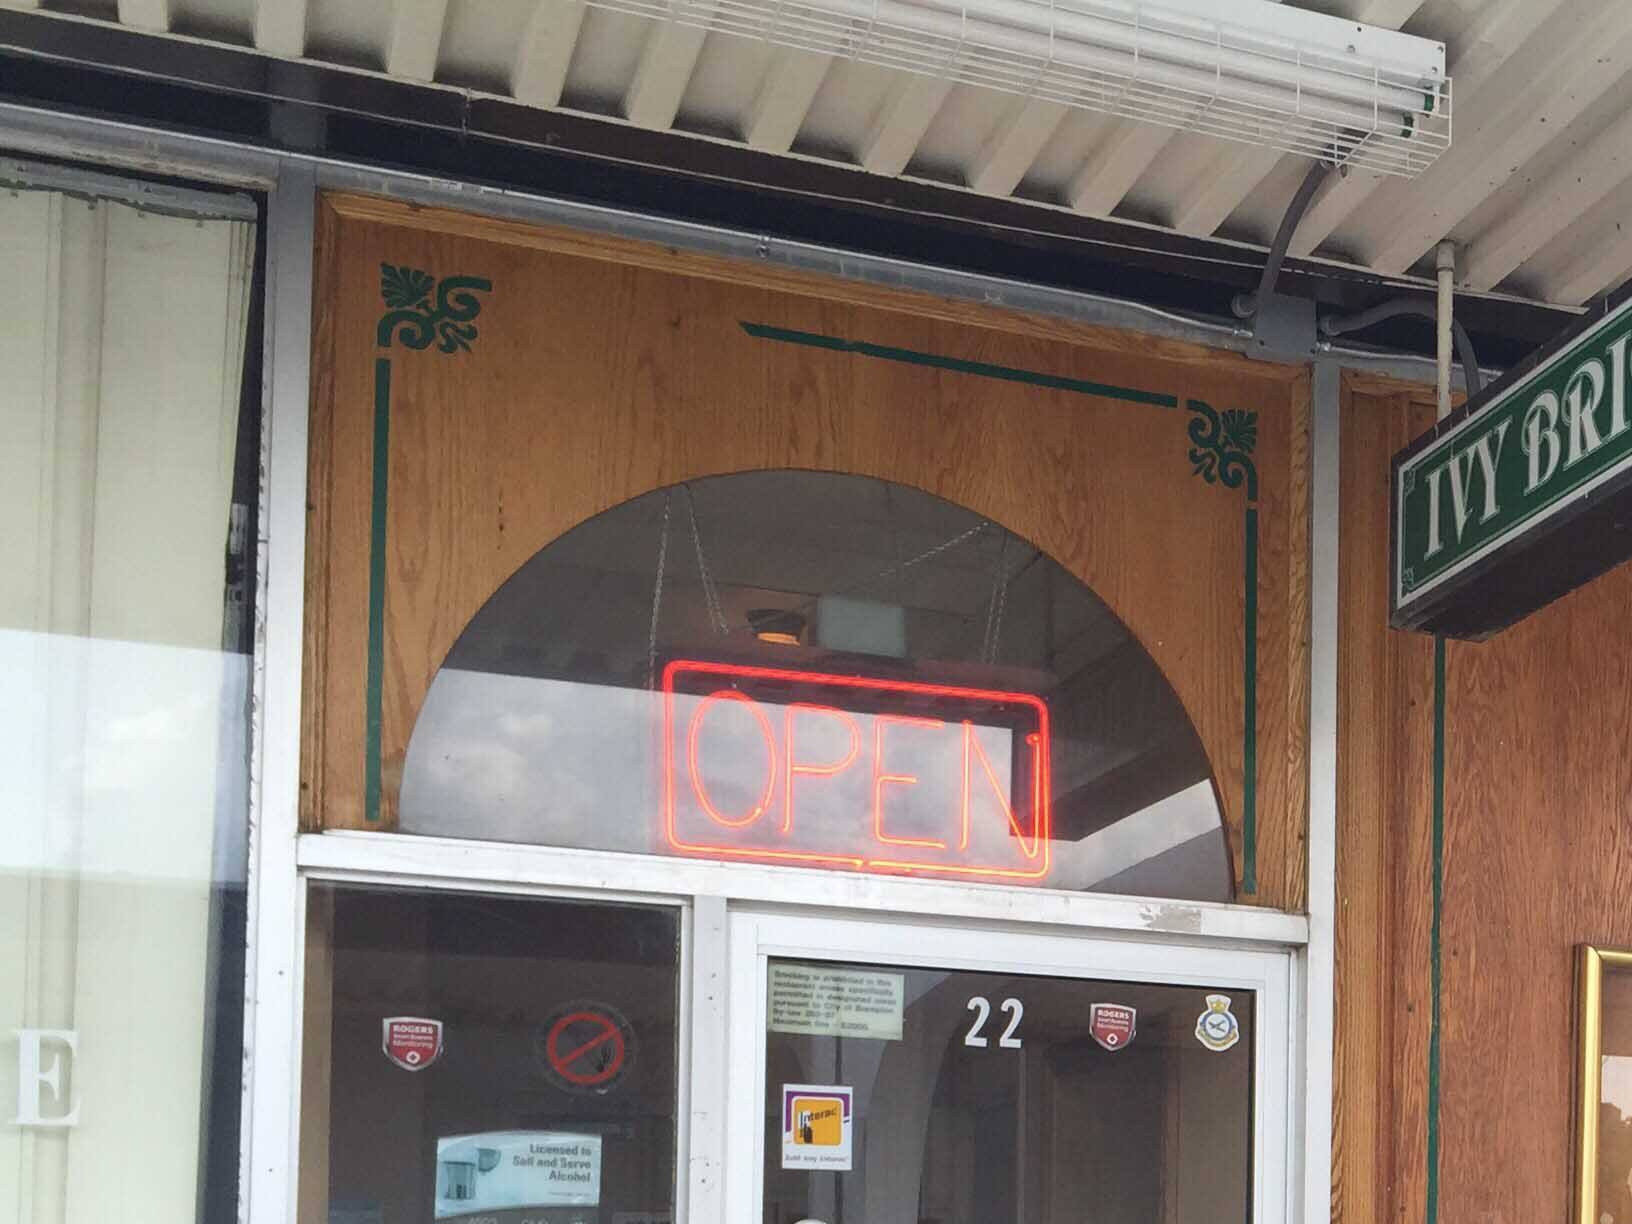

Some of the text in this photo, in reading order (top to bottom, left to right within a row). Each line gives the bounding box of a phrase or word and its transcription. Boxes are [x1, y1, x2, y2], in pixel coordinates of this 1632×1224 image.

[1423, 415, 1513, 561] IVY
[688, 688, 1042, 860] OPEN
[1098, 1009, 1130, 1020] ROGERS
[965, 996, 1024, 1048] 22
[393, 1025, 433, 1034] ROGERS
[529, 1143, 579, 1156] Licensed
[536, 1156, 558, 1167] and
[549, 1172, 592, 1183] Alcohol
